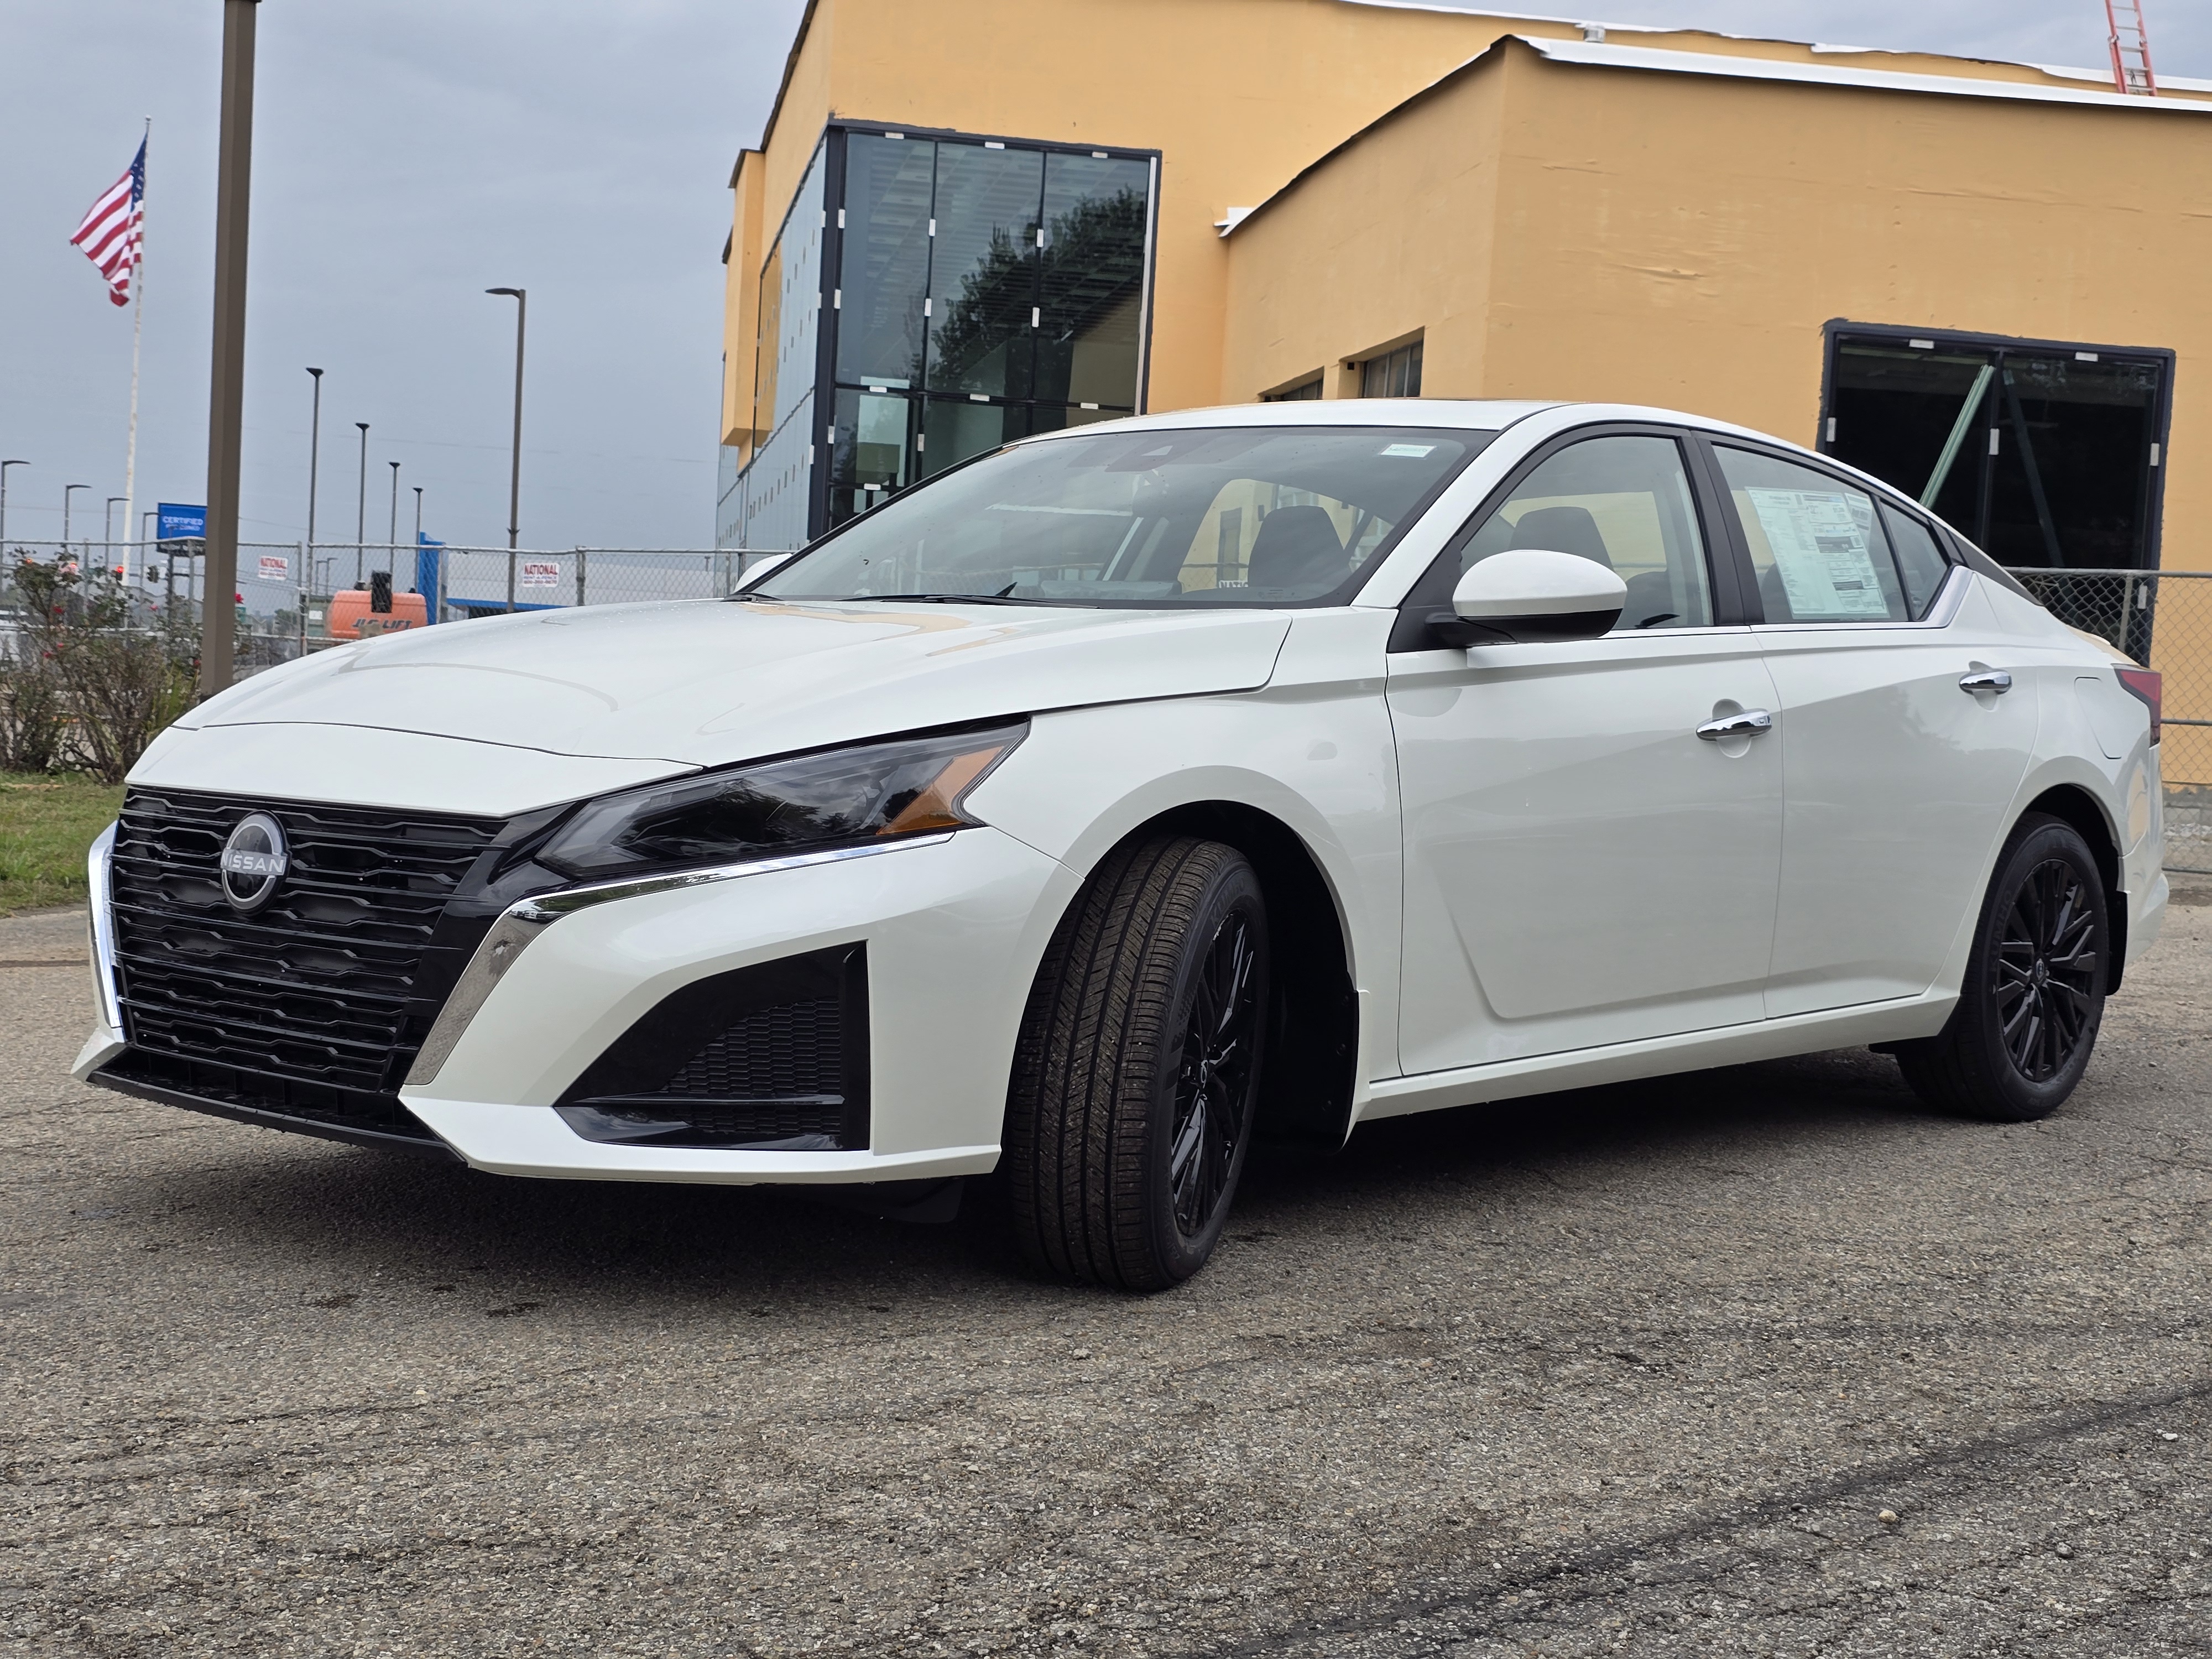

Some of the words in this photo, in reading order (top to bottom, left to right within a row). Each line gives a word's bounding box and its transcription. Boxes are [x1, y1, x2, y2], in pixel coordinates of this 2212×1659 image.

[524, 564, 558, 575] NATIONAL
[382, 619, 413, 629] LIFT
[221, 854, 284, 873] NISSAN
